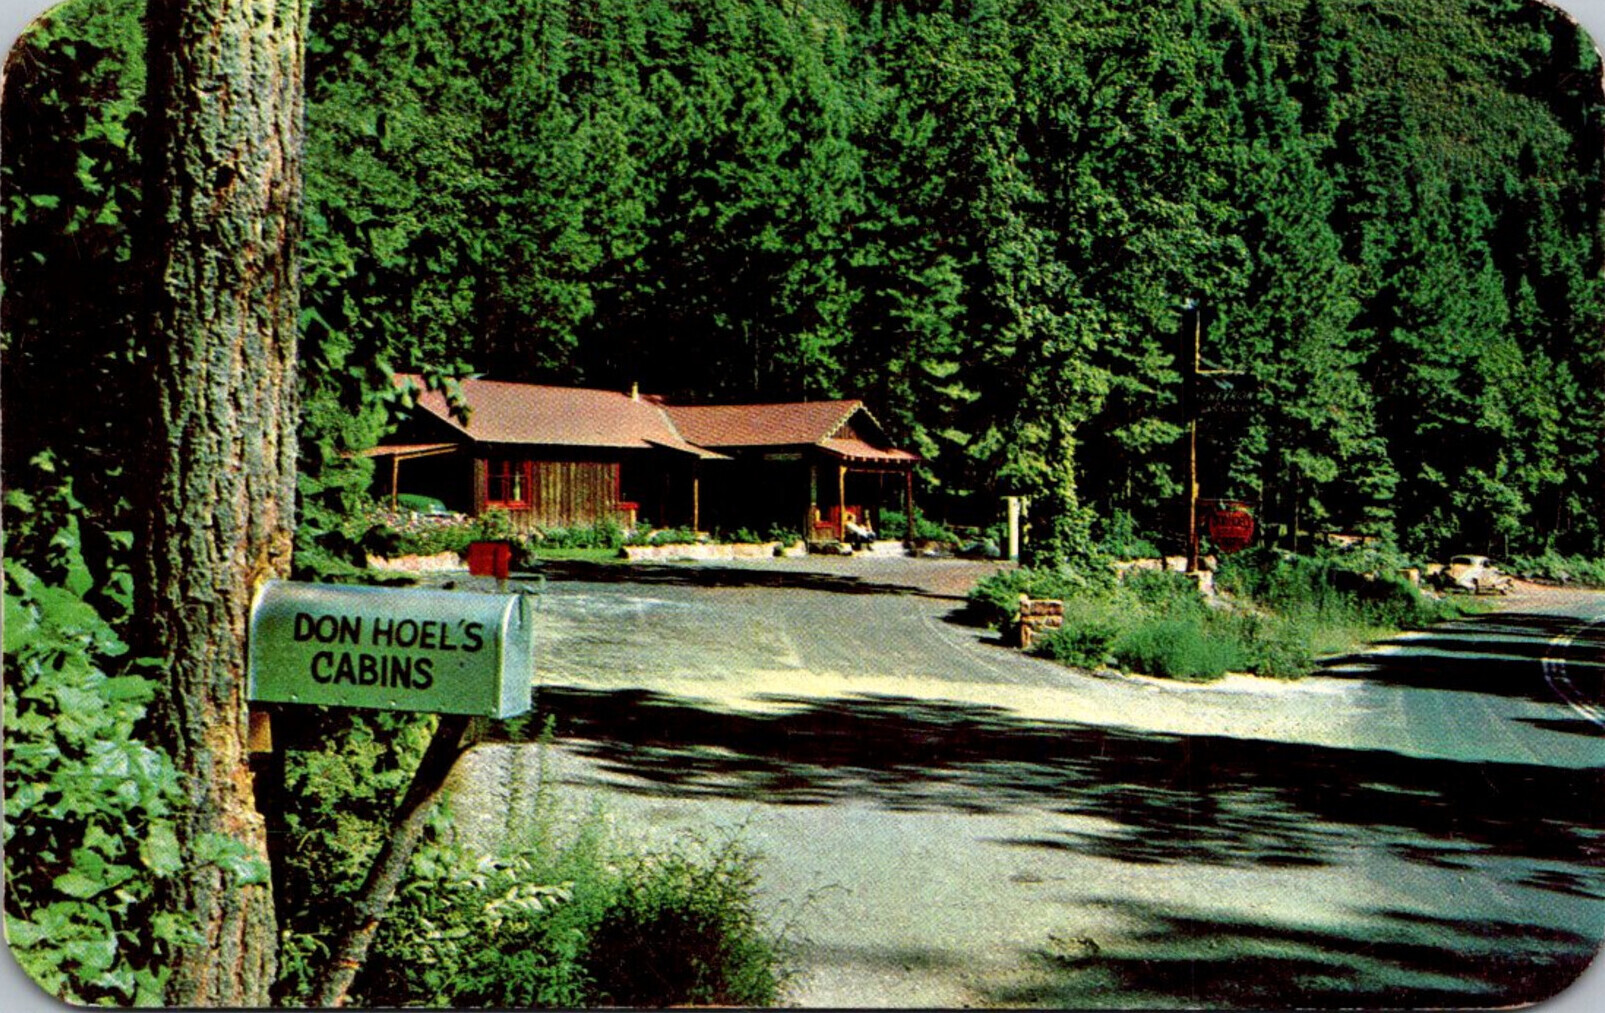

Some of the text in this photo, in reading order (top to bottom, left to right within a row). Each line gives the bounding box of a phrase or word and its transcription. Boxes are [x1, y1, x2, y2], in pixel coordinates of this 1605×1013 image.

[293, 612, 484, 653] DON HOEL'S
[310, 650, 434, 690] CABINS
